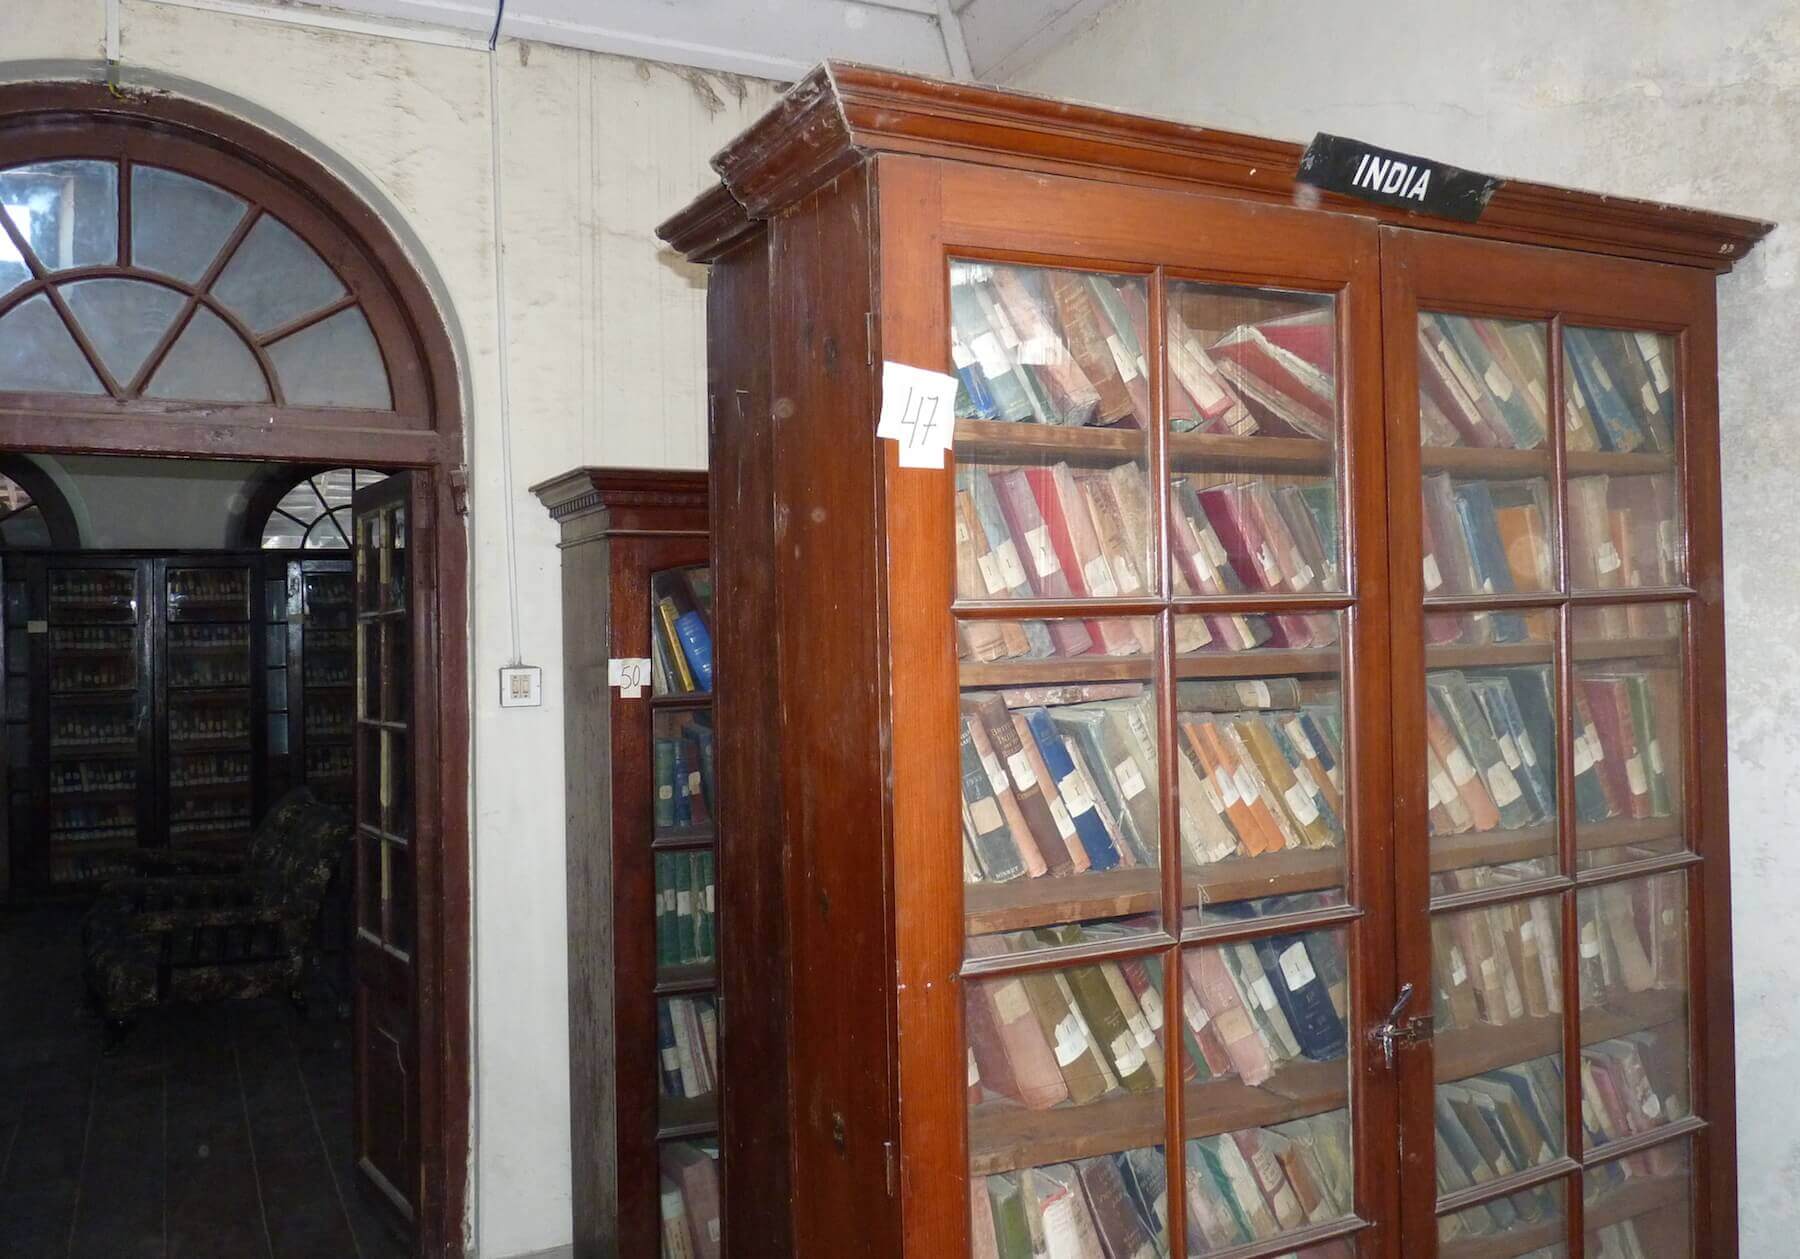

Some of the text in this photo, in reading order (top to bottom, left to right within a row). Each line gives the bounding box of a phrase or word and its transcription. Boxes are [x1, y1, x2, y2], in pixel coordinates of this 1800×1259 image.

[1352, 154, 1431, 201] INDIA
[901, 386, 939, 449] 47
[621, 664, 641, 690] 50
